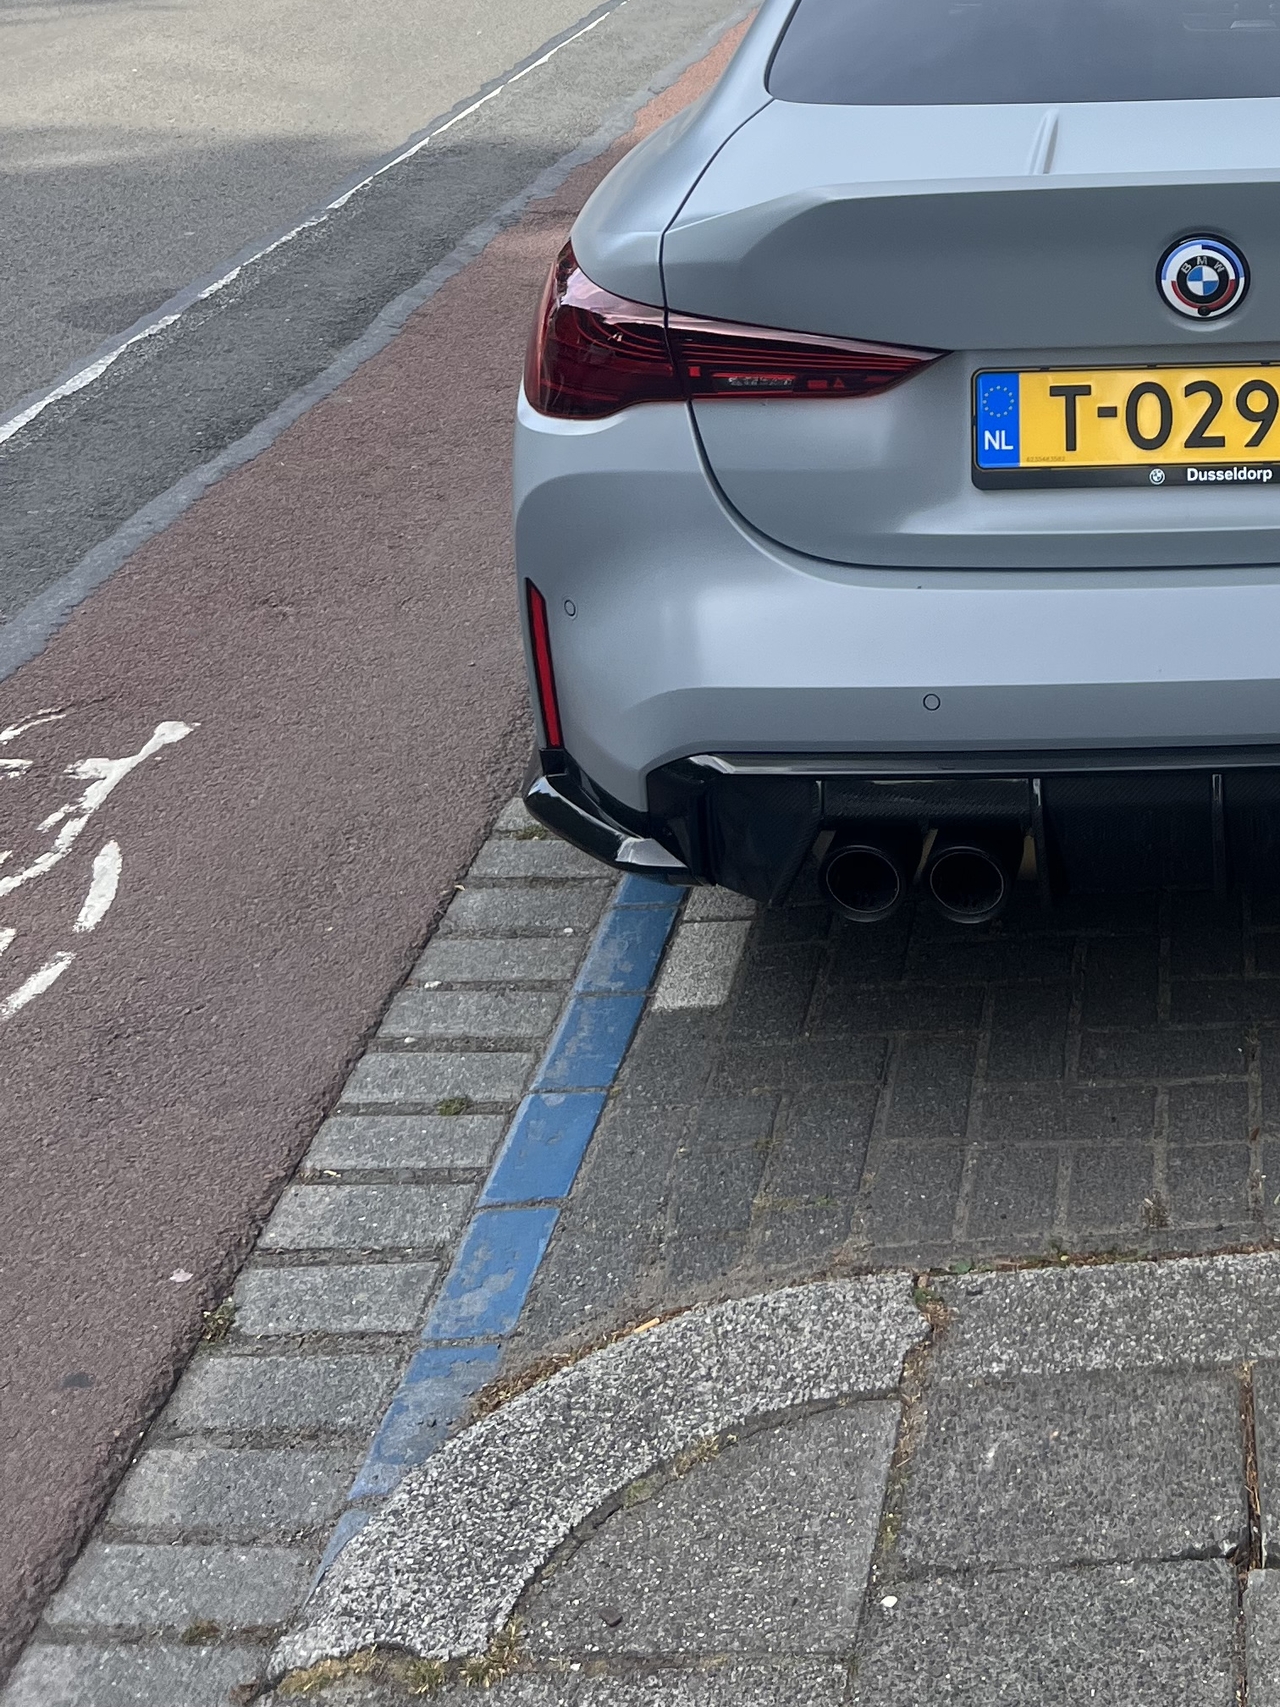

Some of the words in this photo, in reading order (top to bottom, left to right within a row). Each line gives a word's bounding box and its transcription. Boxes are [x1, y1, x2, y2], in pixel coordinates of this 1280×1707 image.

[1181, 256, 1225, 274] BMW
[984, 429, 1014, 451] NL
[1186, 466, 1273, 482] Dusseldorp
